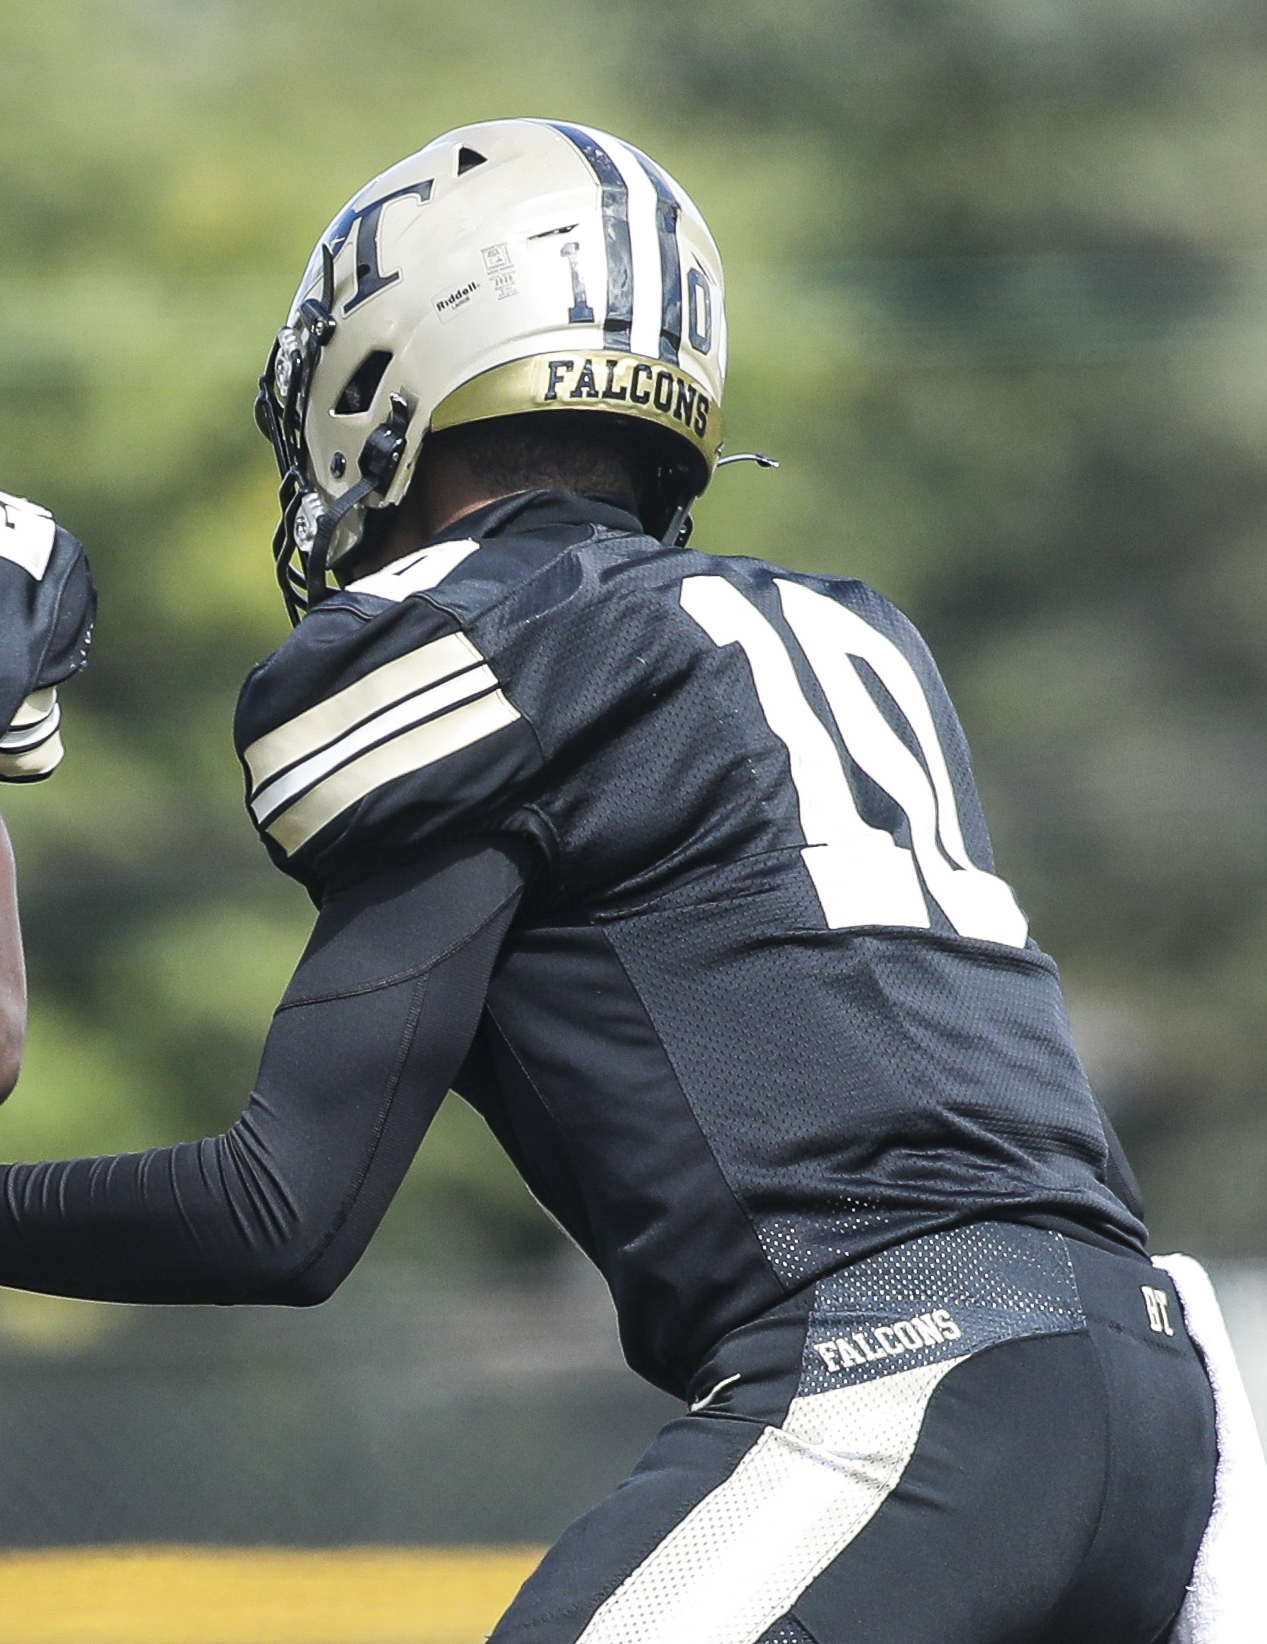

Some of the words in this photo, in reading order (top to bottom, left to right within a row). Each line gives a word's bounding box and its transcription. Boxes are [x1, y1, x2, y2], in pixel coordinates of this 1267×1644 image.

[436, 281, 478, 312] Riddell
[544, 358, 710, 439] FALCONS
[679, 574, 1030, 949] 10
[813, 1308, 962, 1373] FALCONS
[1140, 1285, 1174, 1336] BT
